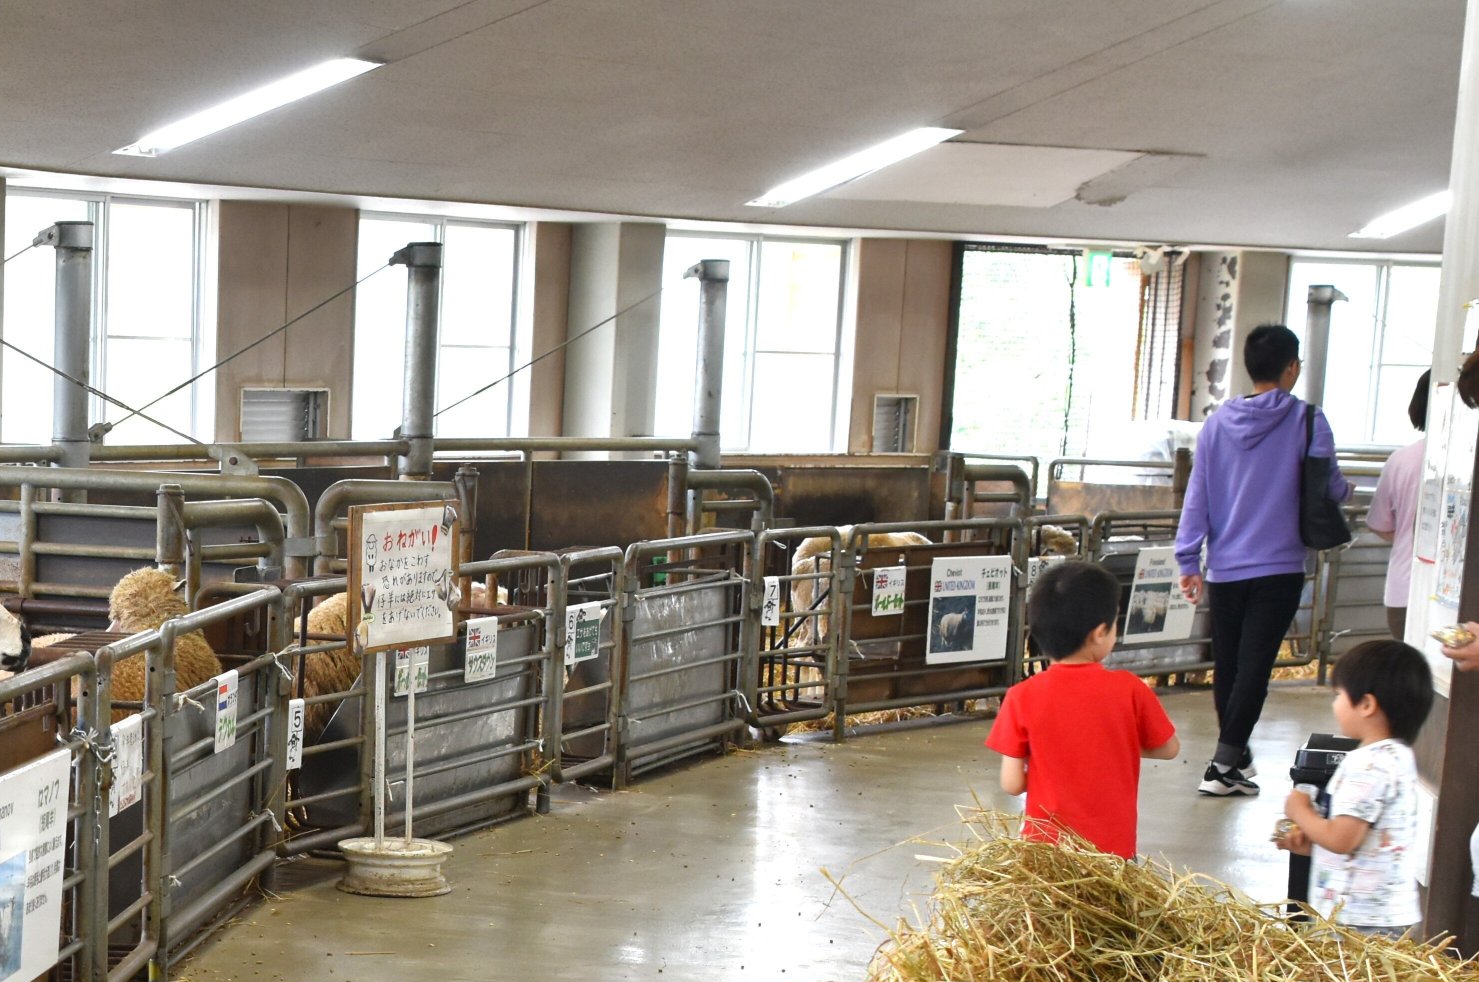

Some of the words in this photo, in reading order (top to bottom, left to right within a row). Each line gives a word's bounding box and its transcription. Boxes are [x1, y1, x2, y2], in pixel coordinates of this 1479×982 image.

[379, 554, 430, 572] おなかをこわす
[1031, 564, 1037, 577] 8
[770, 584, 777, 597] 7
[569, 614, 574, 630] 6
[293, 710, 301, 728] 5
[38, 778, 60, 808] ロマノフ
